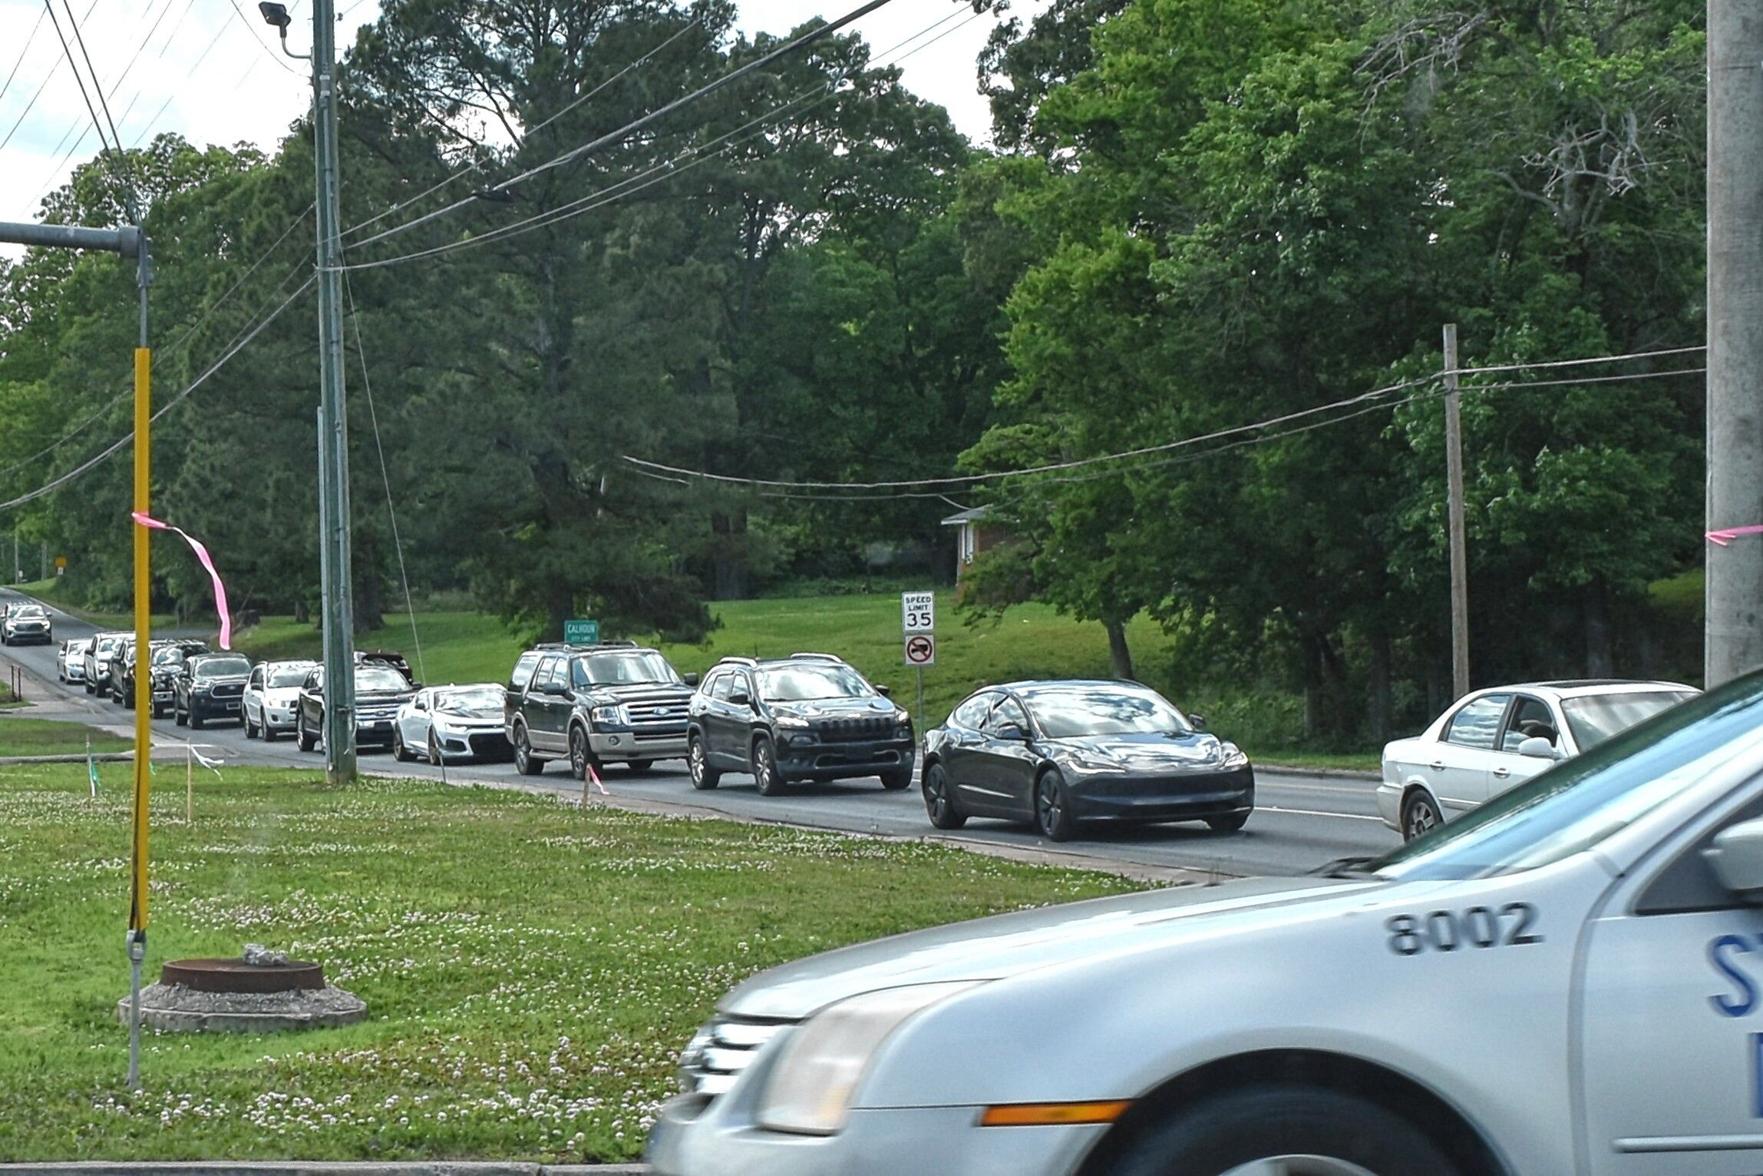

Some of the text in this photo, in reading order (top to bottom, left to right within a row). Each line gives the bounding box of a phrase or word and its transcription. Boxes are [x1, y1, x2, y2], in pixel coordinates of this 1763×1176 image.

[905, 596, 931, 604] SPEED
[907, 612, 931, 627] 35
[1386, 902, 1543, 955] 8002
[1706, 933, 1763, 1017] S
